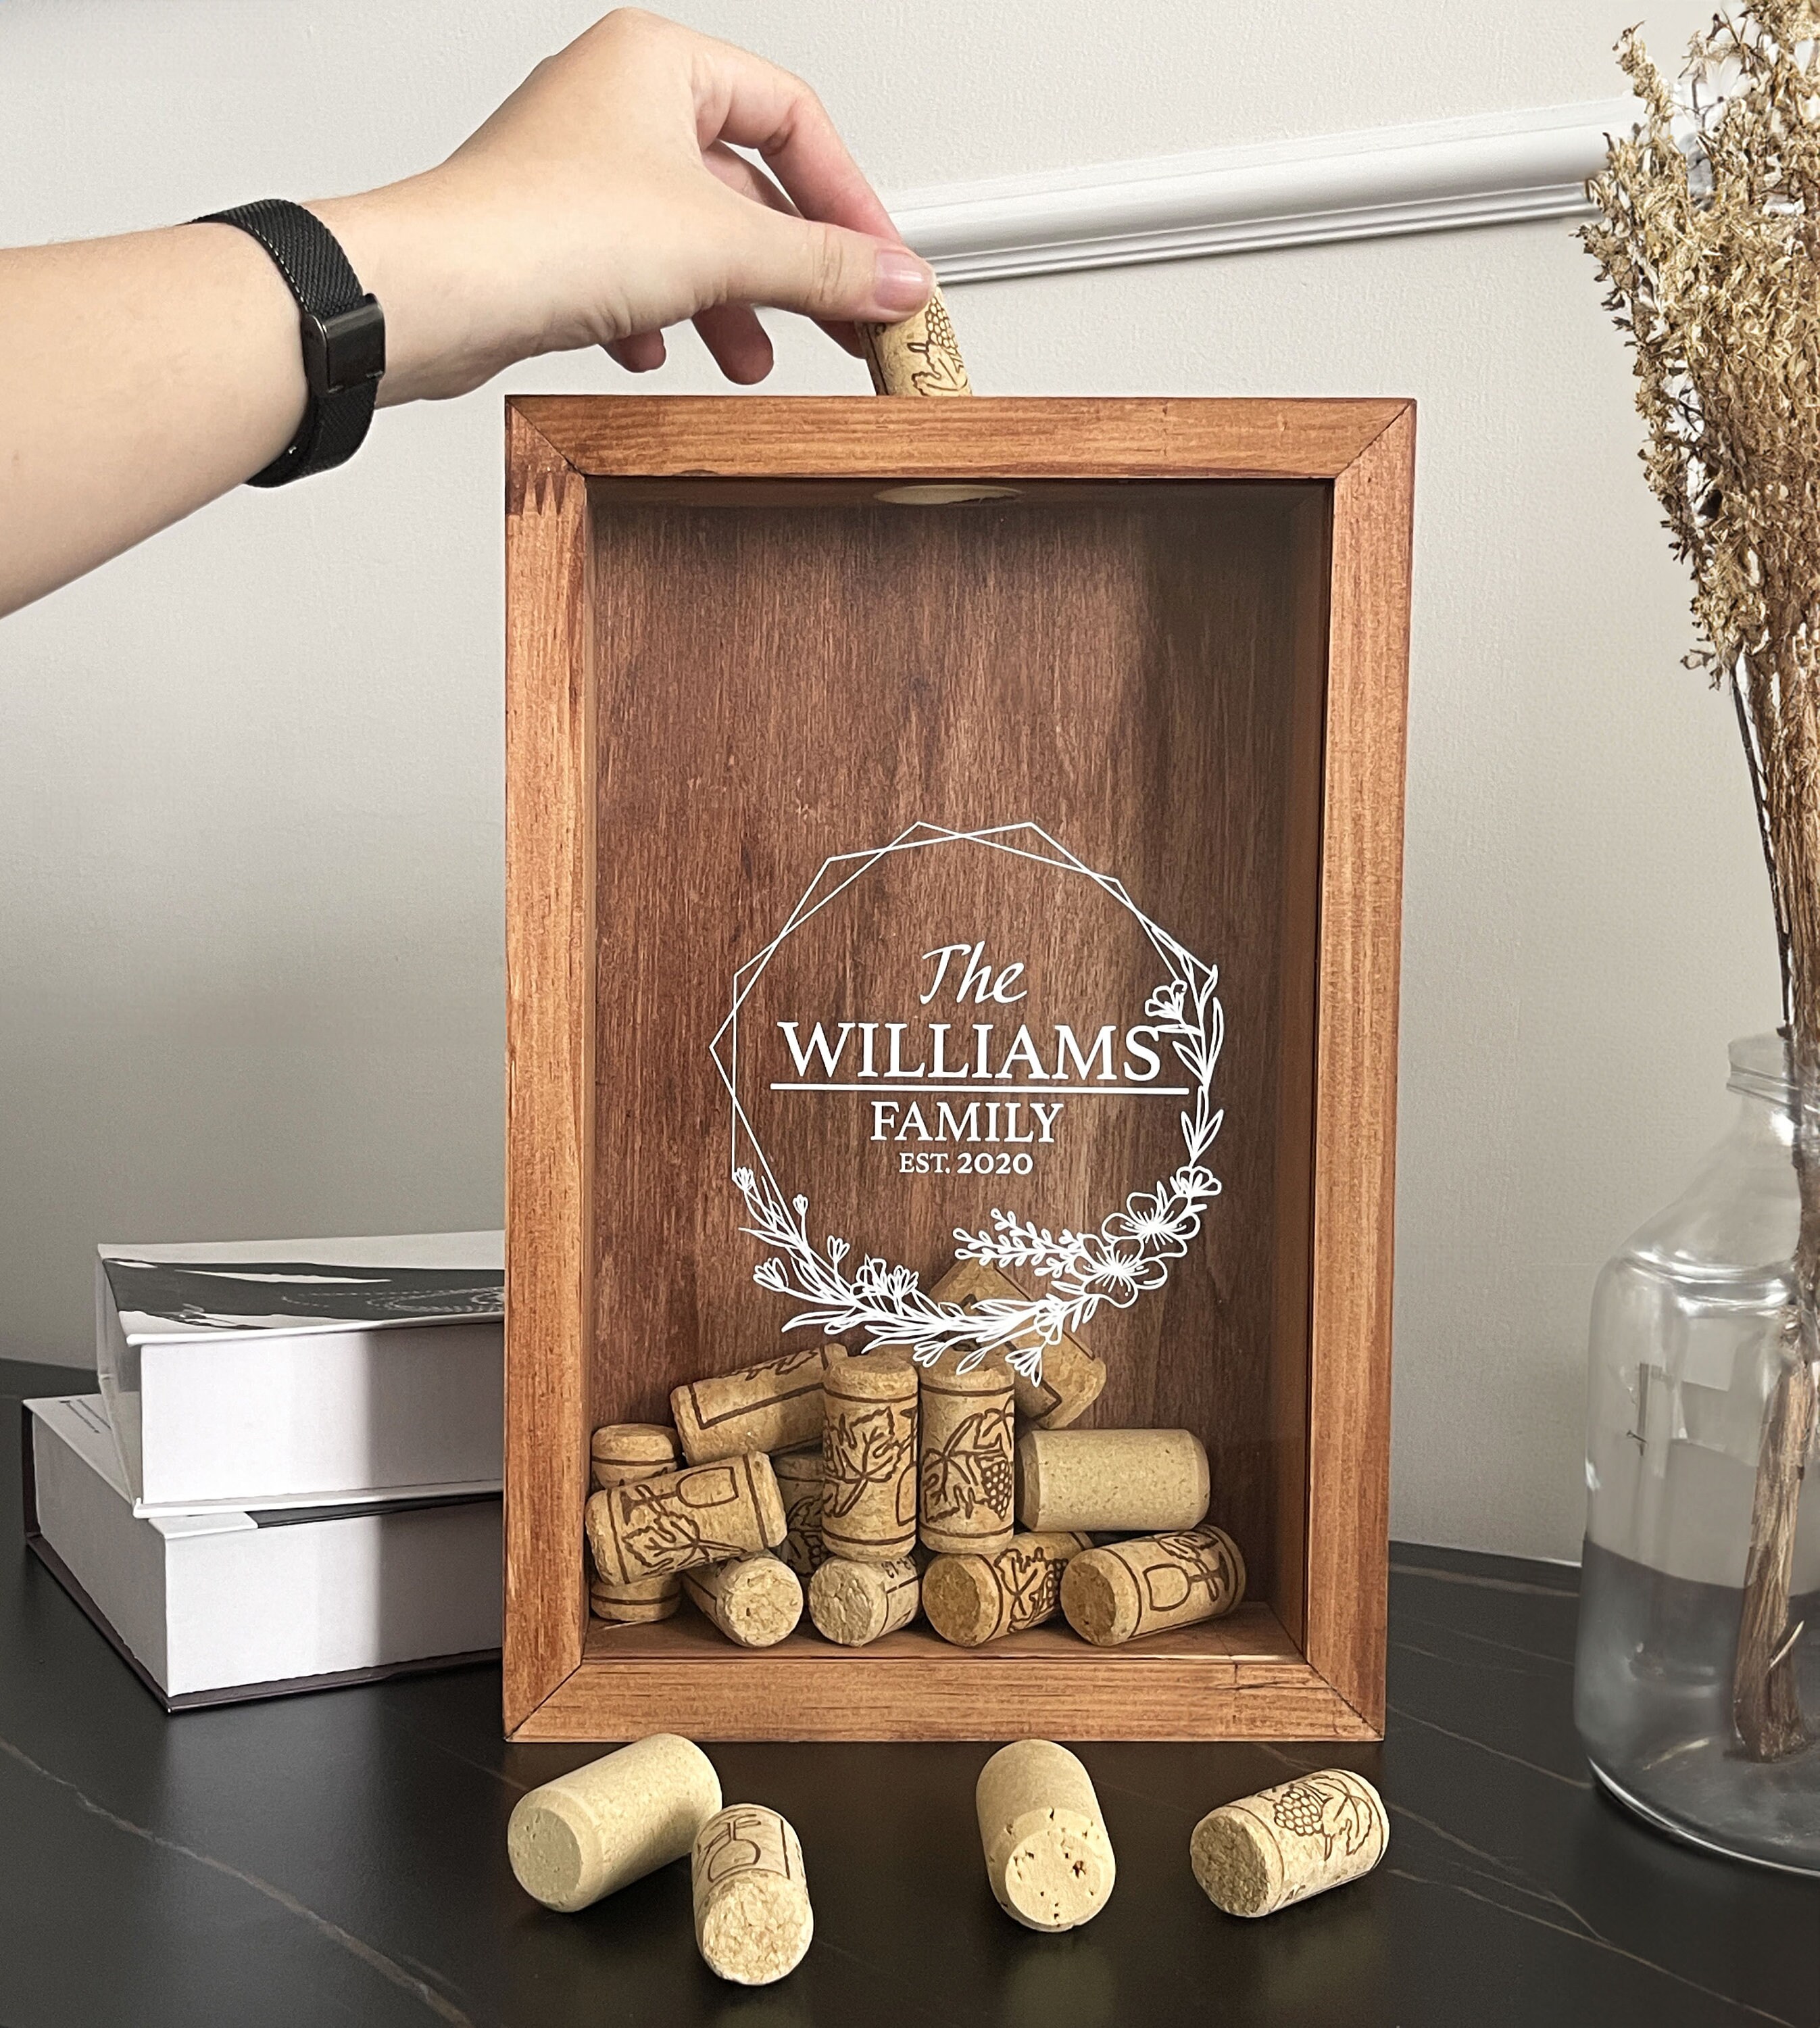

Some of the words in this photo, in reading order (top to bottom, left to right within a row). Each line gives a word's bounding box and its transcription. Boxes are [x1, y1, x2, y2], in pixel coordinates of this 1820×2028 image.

[920, 940, 1027, 1005] The
[777, 1021, 1161, 1082] WILLIAMS
[870, 1101, 1065, 1144] FAMILY
[899, 1152, 951, 1175] EST.
[956, 1152, 1034, 1175] 2020
